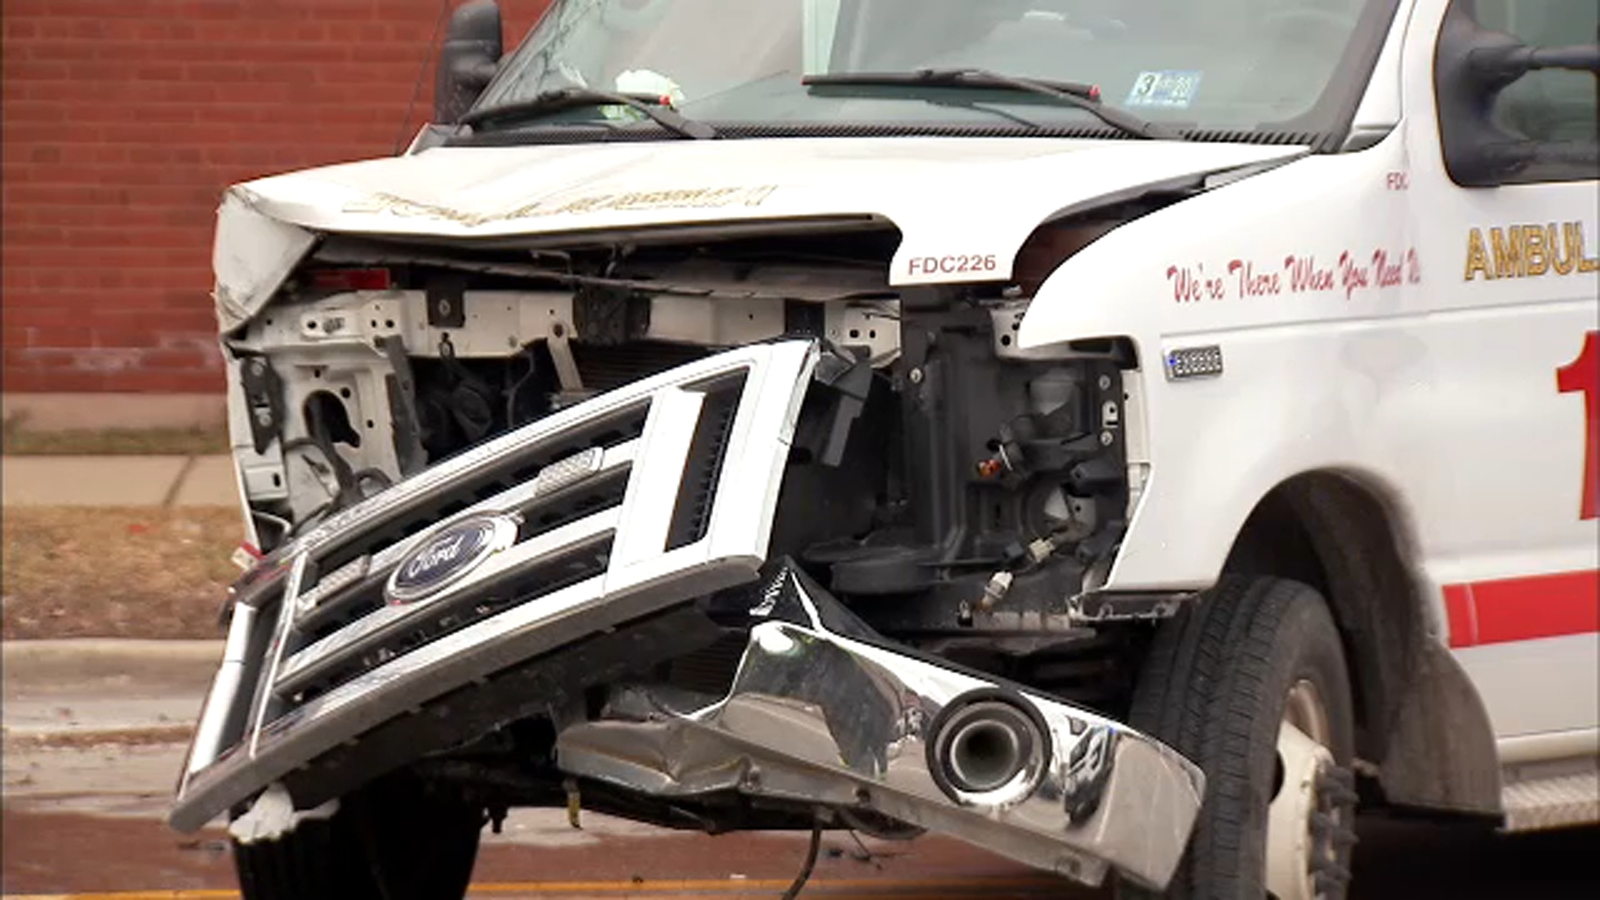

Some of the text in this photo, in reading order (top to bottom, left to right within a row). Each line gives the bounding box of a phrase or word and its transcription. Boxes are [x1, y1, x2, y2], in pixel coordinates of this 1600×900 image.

[1137, 74, 1156, 96] 3
[908, 254, 997, 275] FDC226
[1166, 262, 1226, 303] We're
[1227, 259, 1281, 299] There
[1284, 254, 1334, 292] When
[1338, 249, 1369, 300] You
[407, 534, 467, 579] Ford
